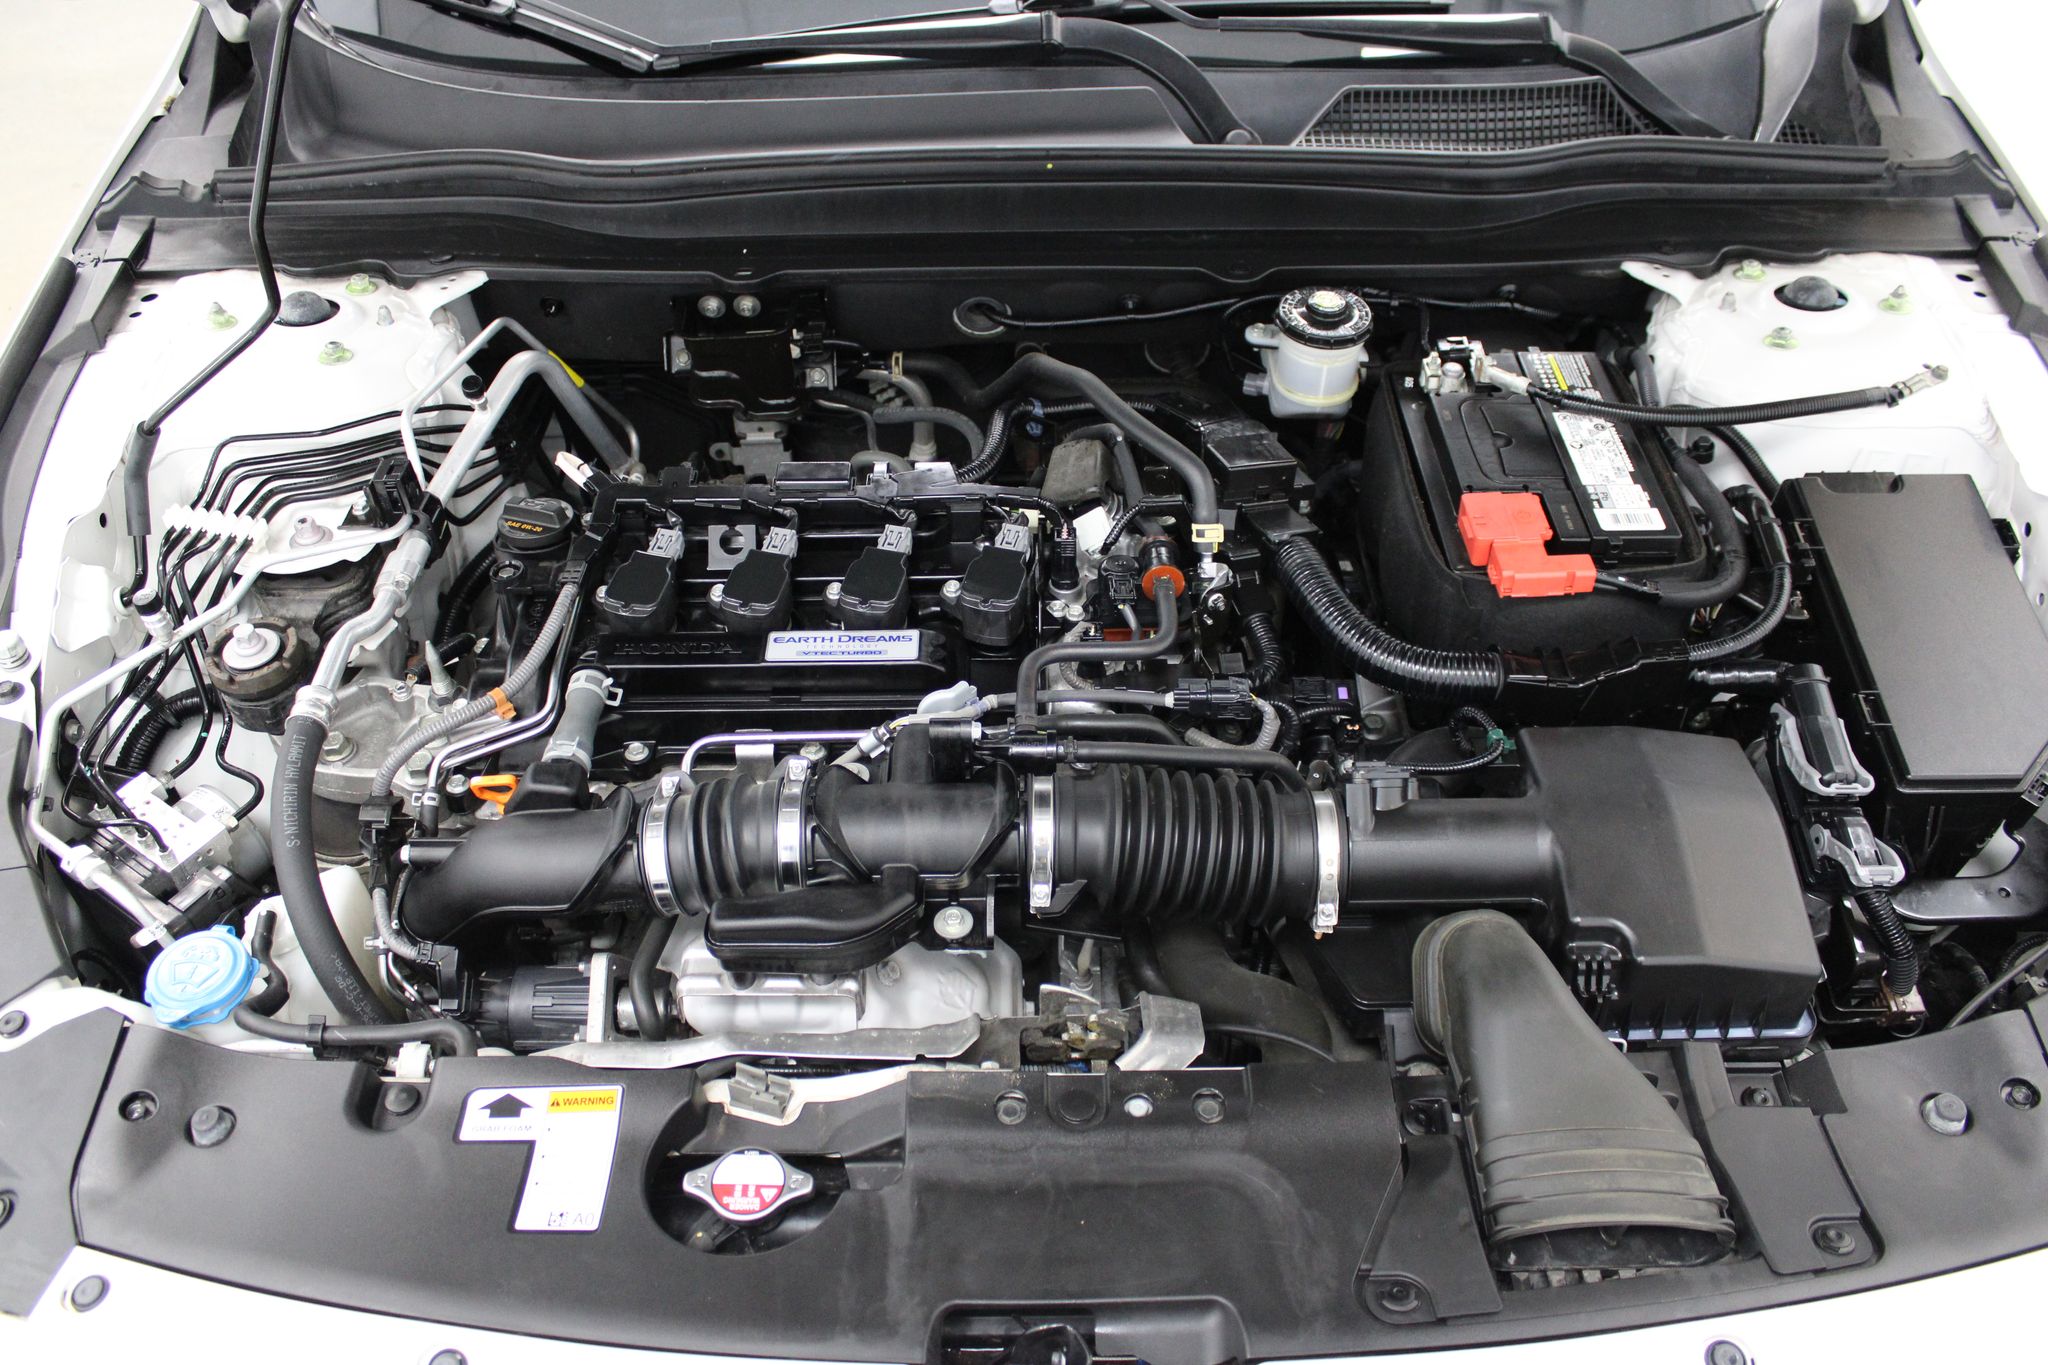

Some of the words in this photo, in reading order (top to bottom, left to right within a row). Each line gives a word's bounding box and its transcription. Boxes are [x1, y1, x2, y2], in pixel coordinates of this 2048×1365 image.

[773, 635, 833, 644] EARTH
[838, 634, 913, 643] DREAMS
[562, 1096, 614, 1107] WARNING
